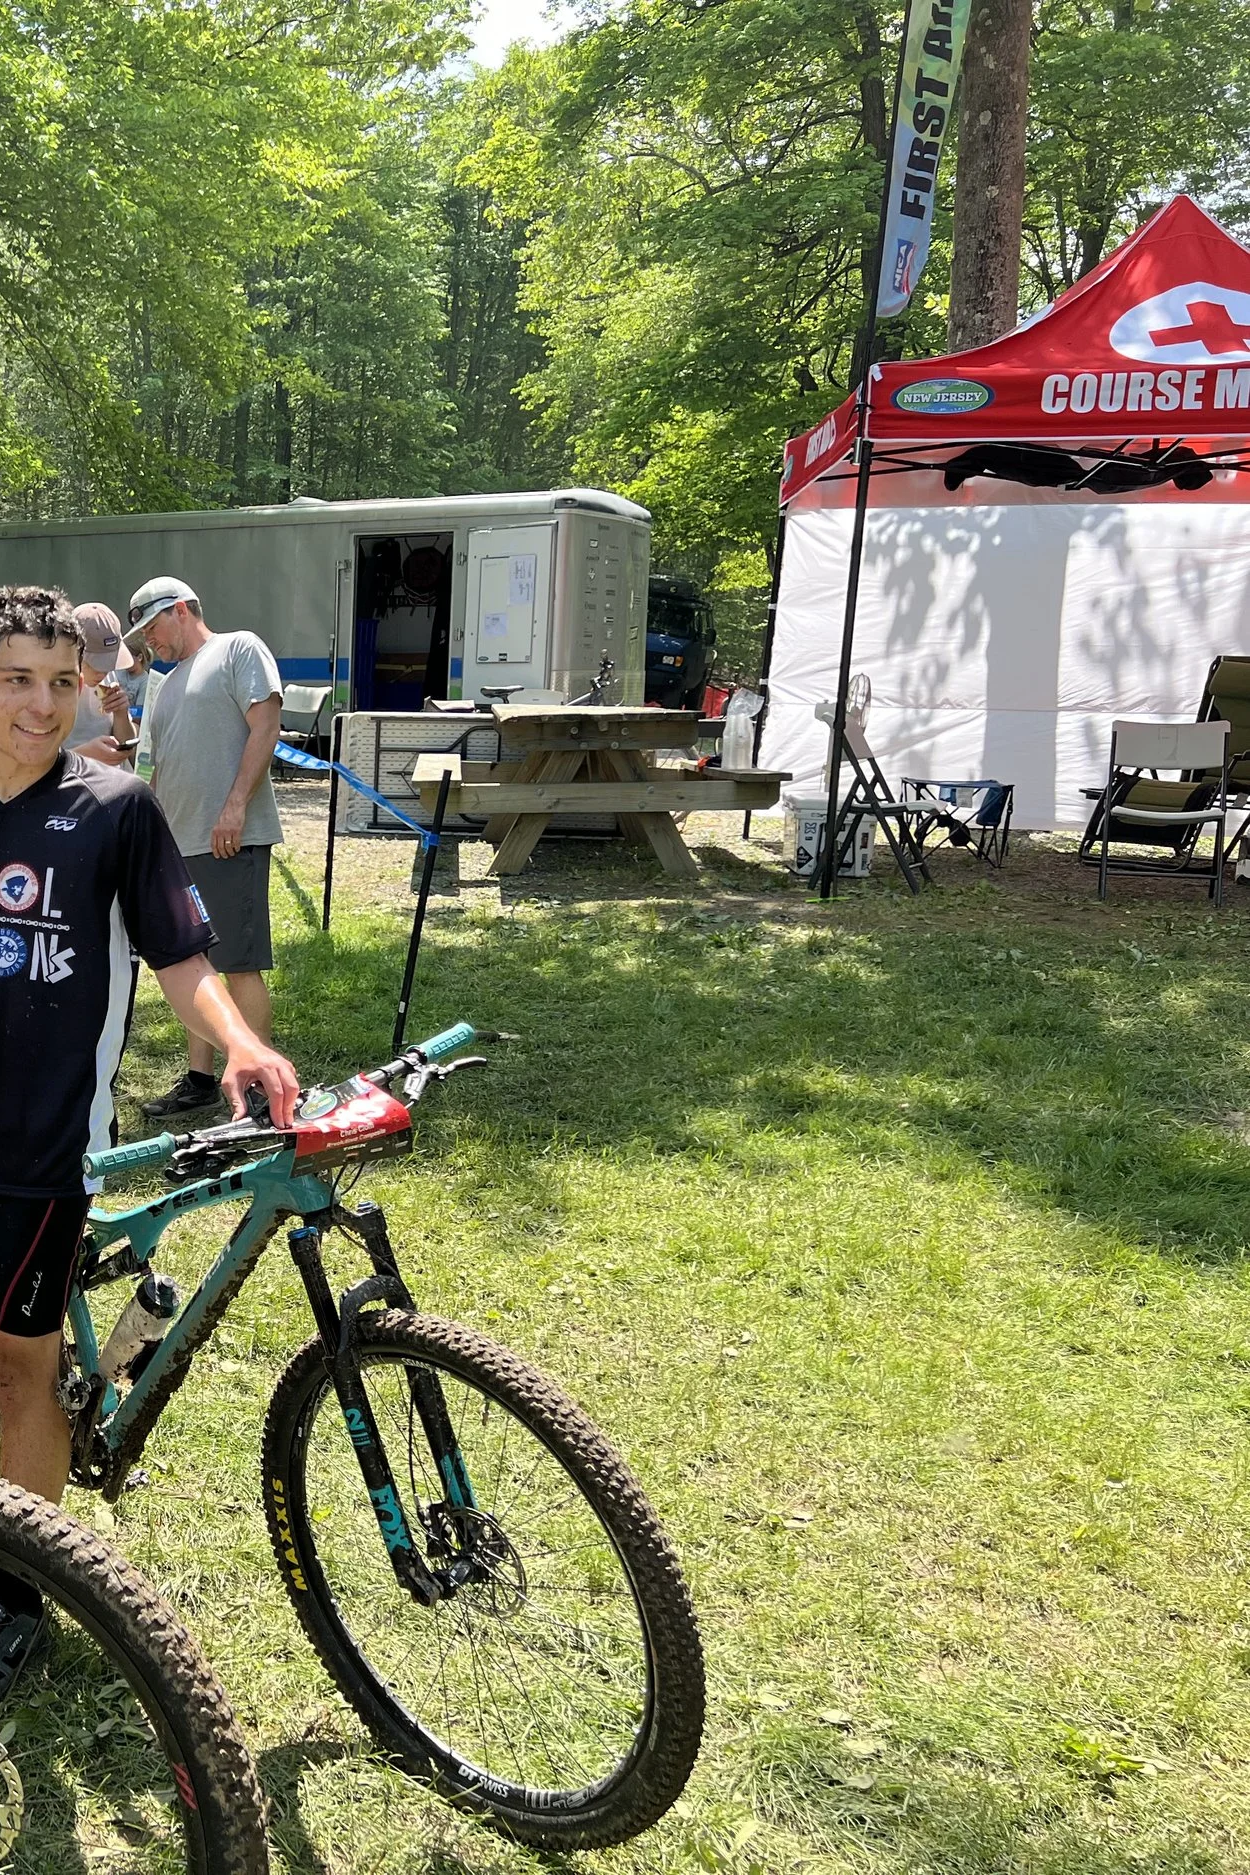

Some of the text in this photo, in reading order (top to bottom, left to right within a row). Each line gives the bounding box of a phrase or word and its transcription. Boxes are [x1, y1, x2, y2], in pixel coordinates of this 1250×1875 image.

[900, 0, 954, 221] FIRST AI
[894, 244, 908, 288] NICA
[903, 391, 983, 403] NEW JERSEY
[1040, 369, 1206, 414] COURSE
[272, 1477, 308, 1591] MAXXIS
[370, 1484, 412, 1554] FOX
[457, 1764, 478, 1781] DT
[478, 1775, 510, 1799] SWISS
